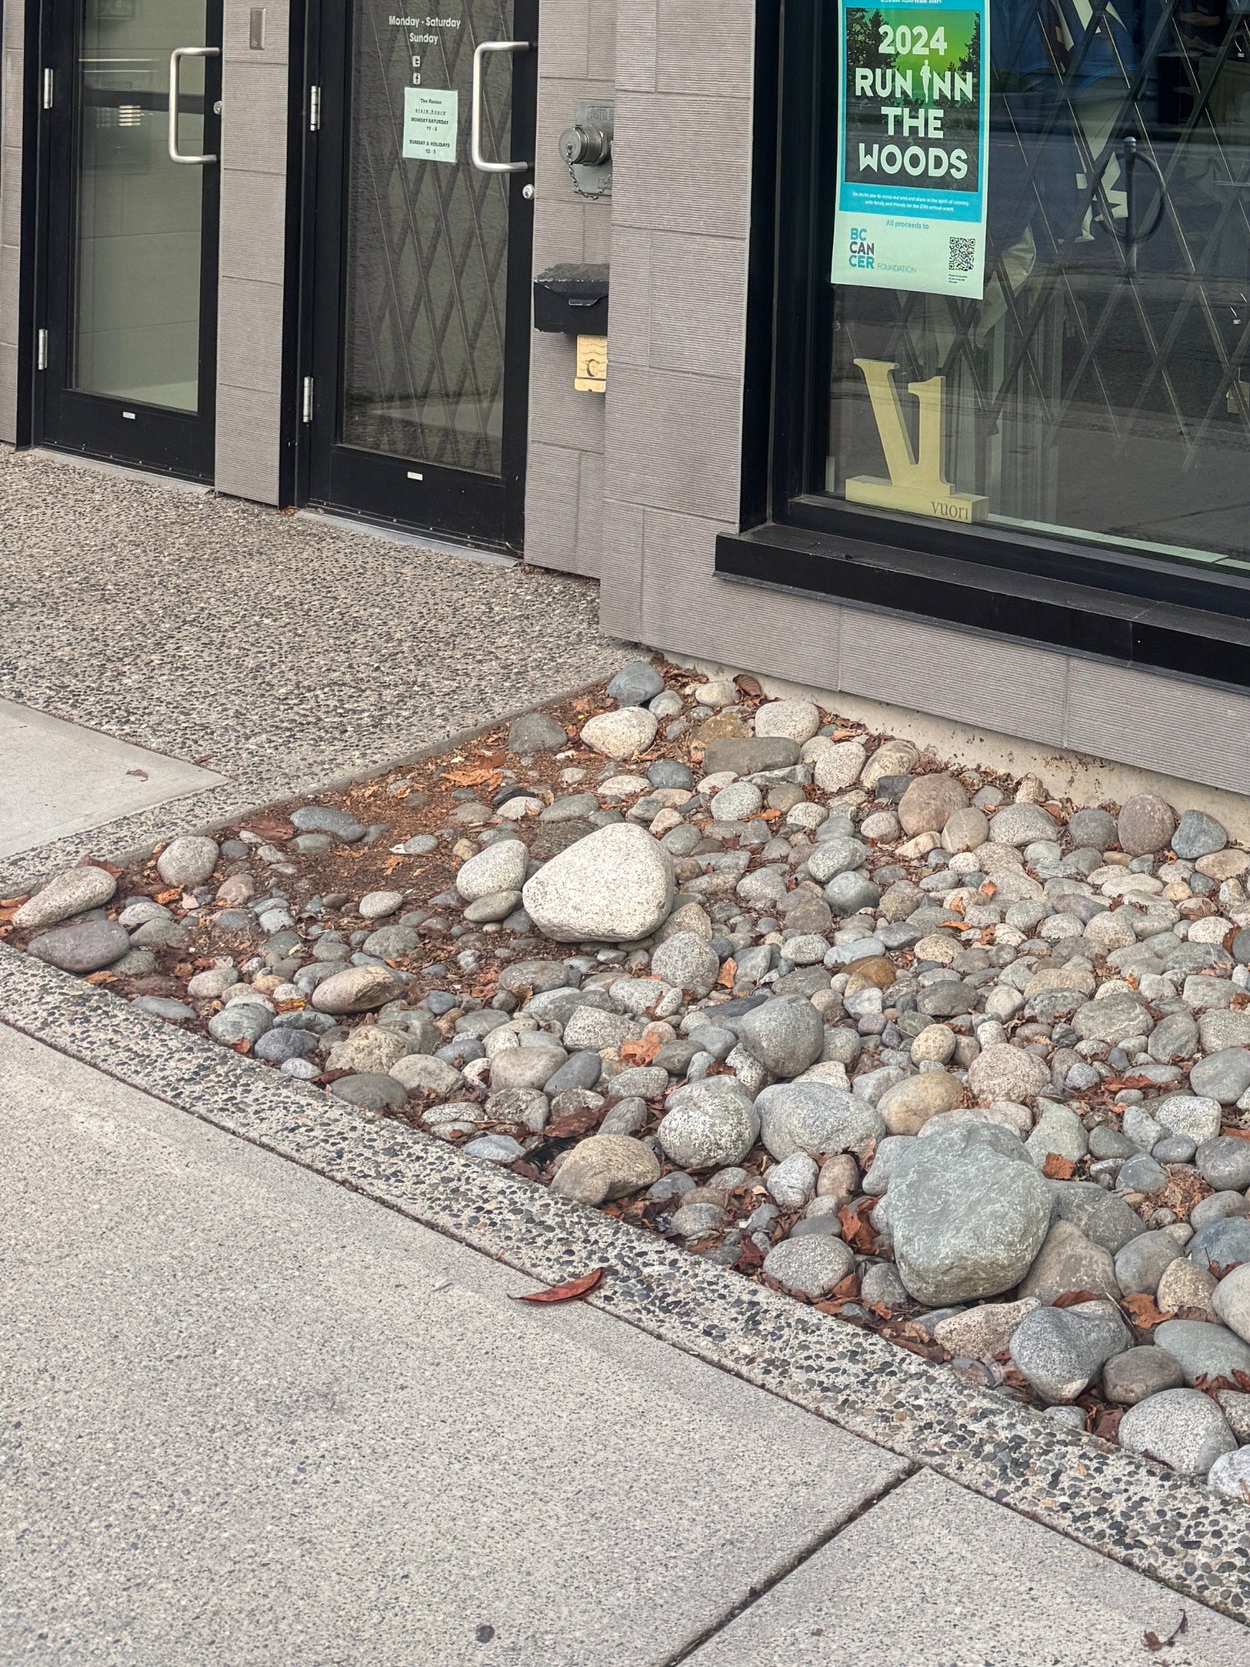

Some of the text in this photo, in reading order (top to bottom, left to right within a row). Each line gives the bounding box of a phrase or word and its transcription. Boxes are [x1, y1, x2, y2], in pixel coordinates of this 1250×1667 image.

[388, 15, 420, 28] Monday
[426, 16, 461, 29] Saturday
[409, 32, 439, 45] Sunday
[878, 24, 947, 56] 2024
[855, 68, 913, 99] RUN
[880, 106, 944, 139] THE
[858, 142, 968, 180] WOODS
[850, 228, 868, 241] BC
[849, 242, 875, 256] CAN
[848, 255, 875, 269] CER
